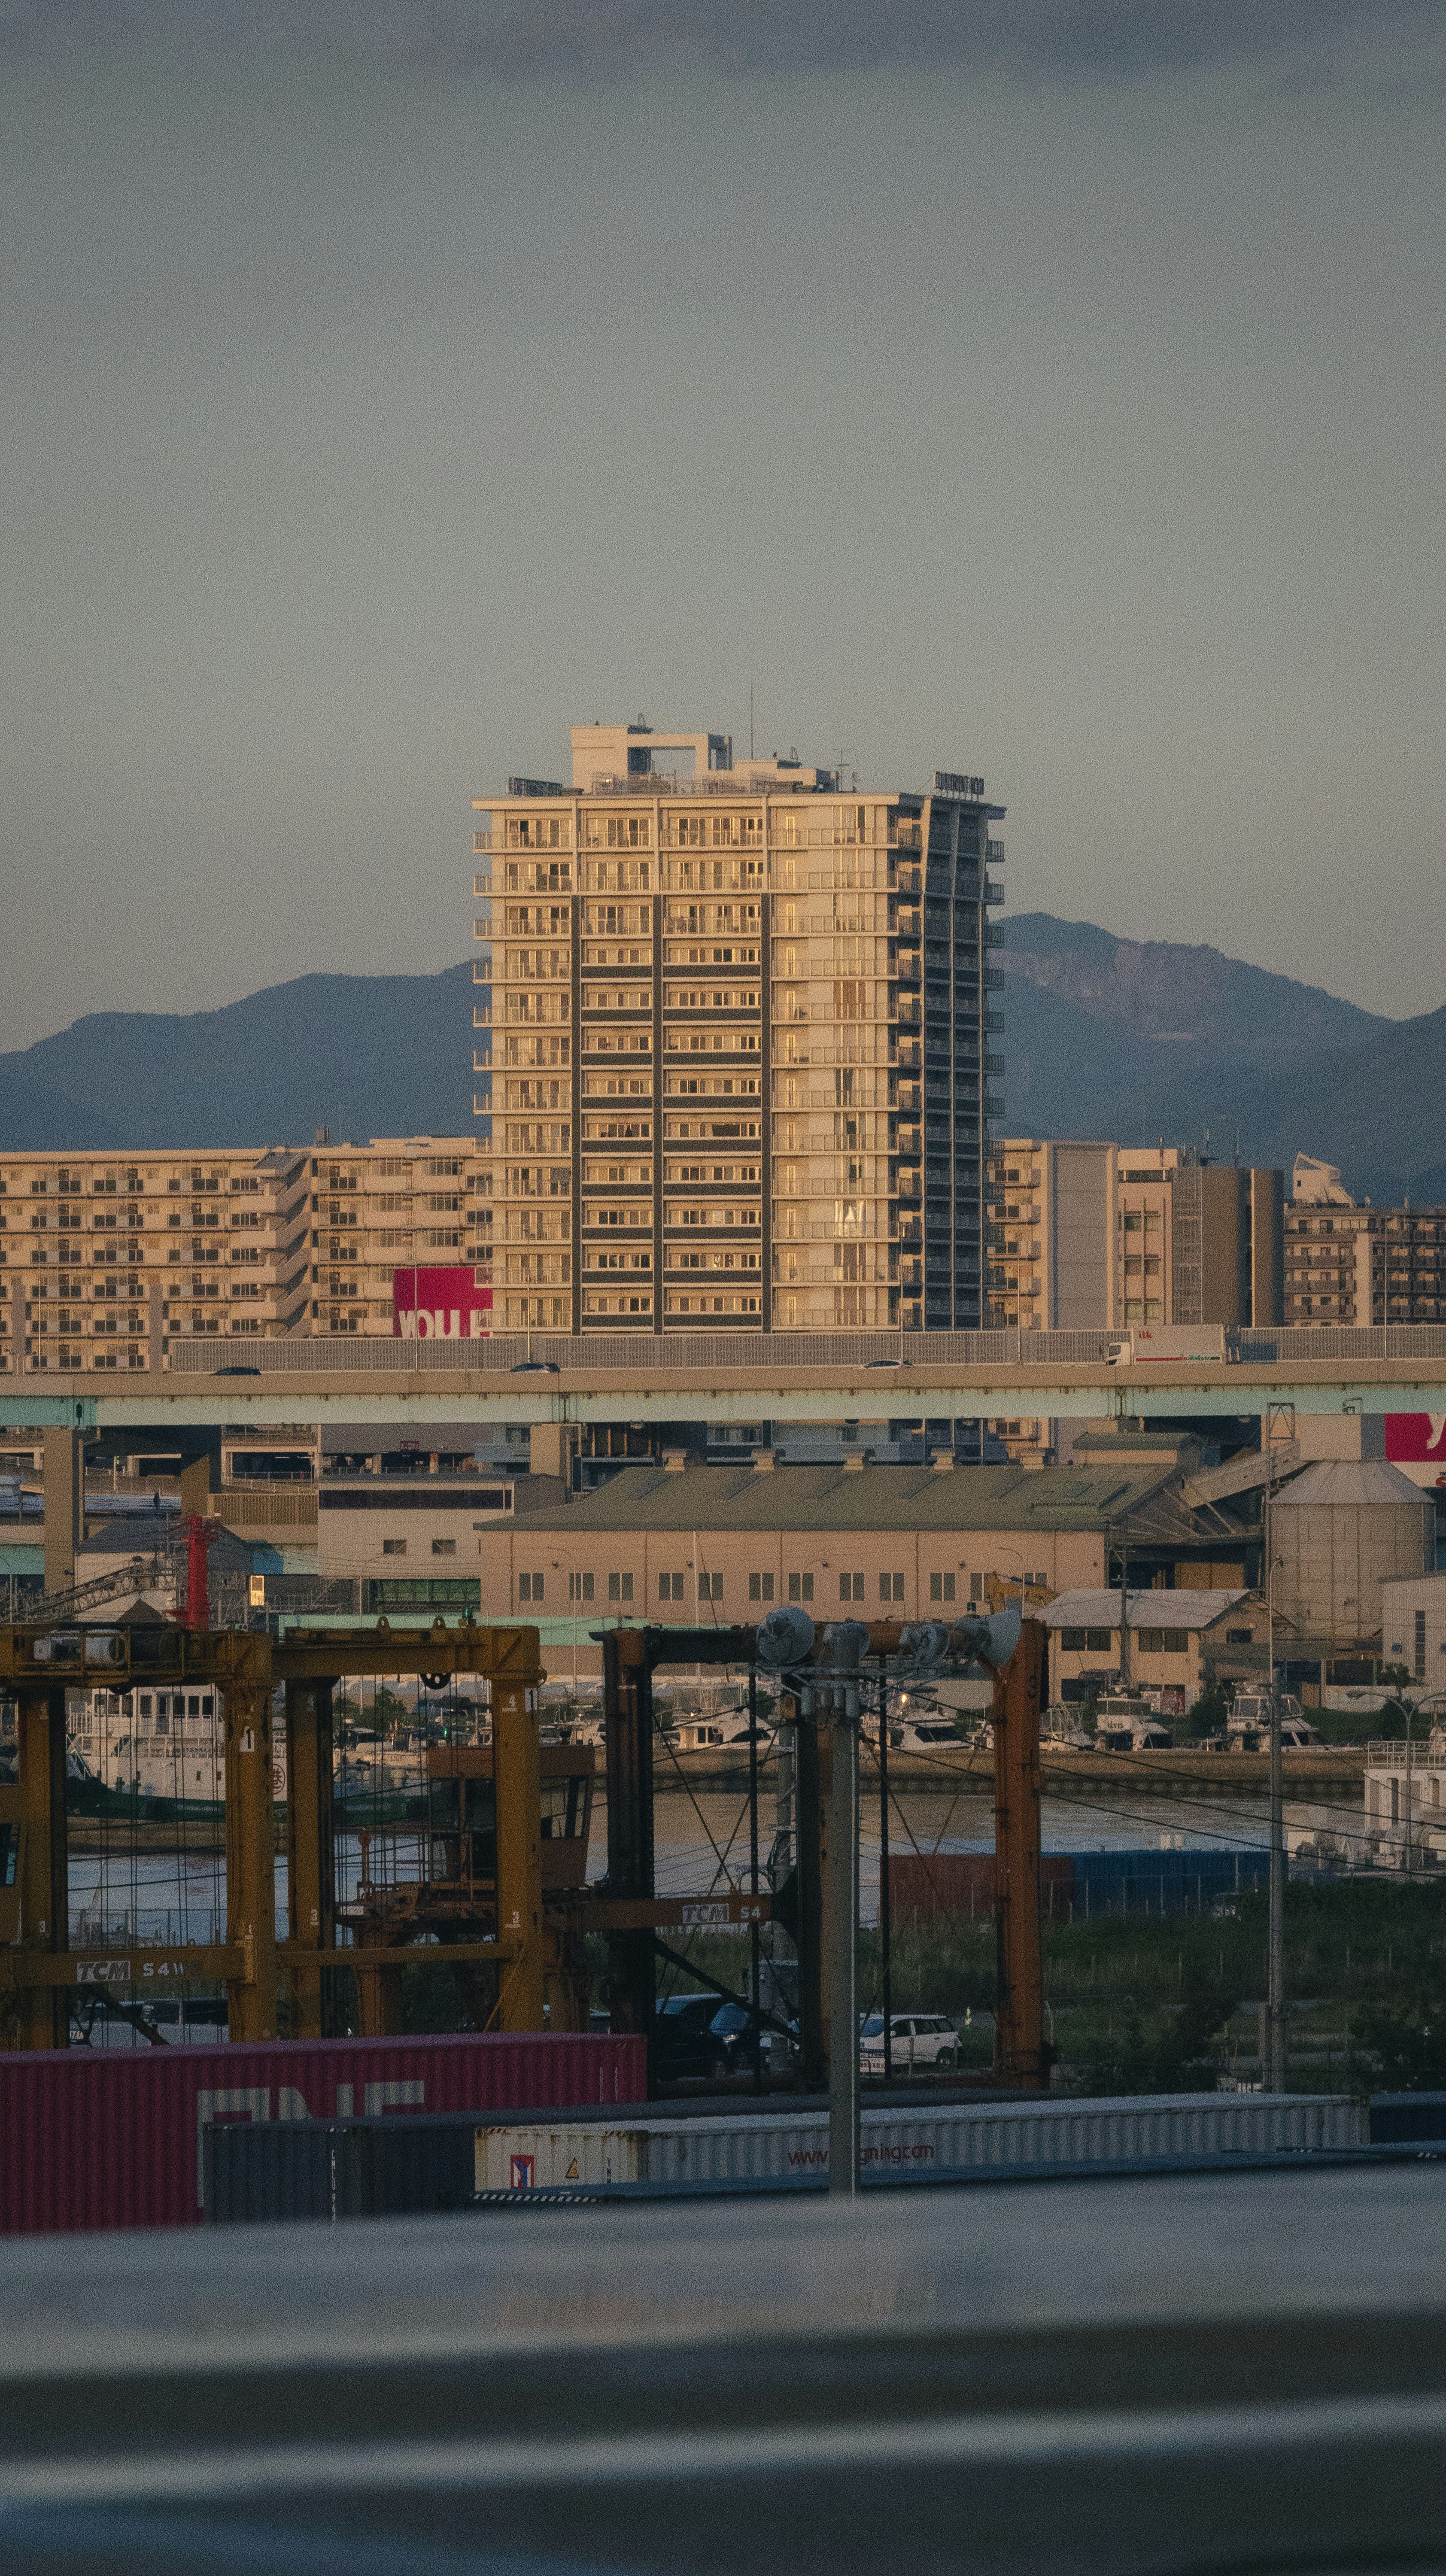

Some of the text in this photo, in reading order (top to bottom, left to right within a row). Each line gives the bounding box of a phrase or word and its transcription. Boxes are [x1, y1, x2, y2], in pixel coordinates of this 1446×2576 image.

[509, 1695, 516, 1707] 4
[529, 1689, 534, 1709] 1
[246, 1728, 251, 1749] 1
[311, 1909, 317, 1921] 3
[512, 1911, 519, 1923] 3
[684, 1905, 728, 1922] TCM
[39, 1920, 46, 1932] 3
[78, 1962, 129, 1981] TCM
